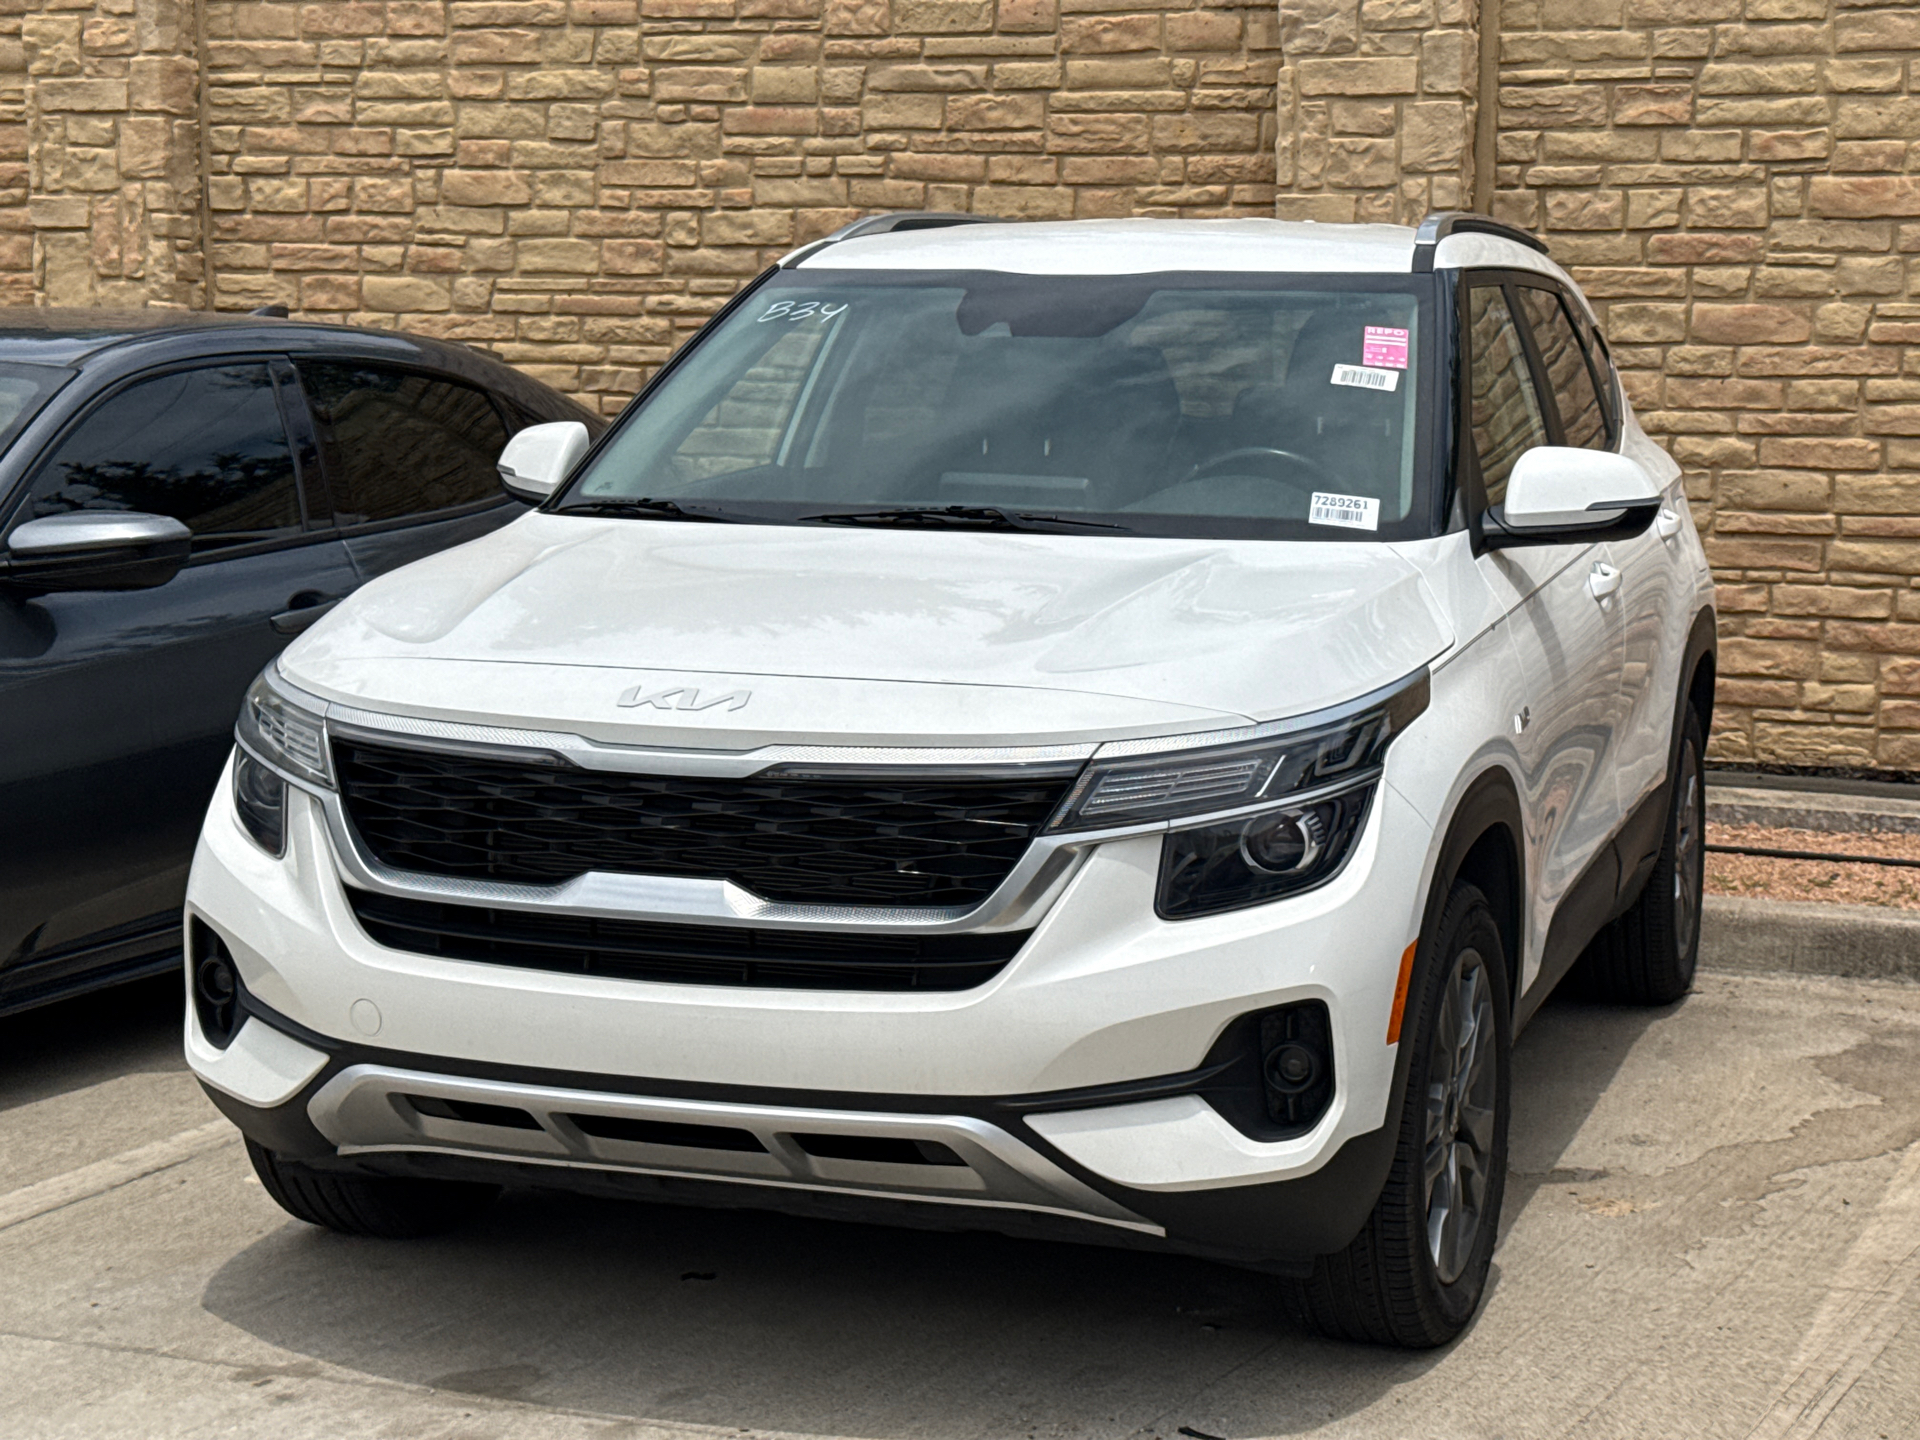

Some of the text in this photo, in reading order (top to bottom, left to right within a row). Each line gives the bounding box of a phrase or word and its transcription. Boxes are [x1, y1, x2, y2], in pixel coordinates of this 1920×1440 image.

[757, 301, 848, 323] B34
[1367, 327, 1405, 336] REPO
[1314, 495, 1368, 510] 7289261
